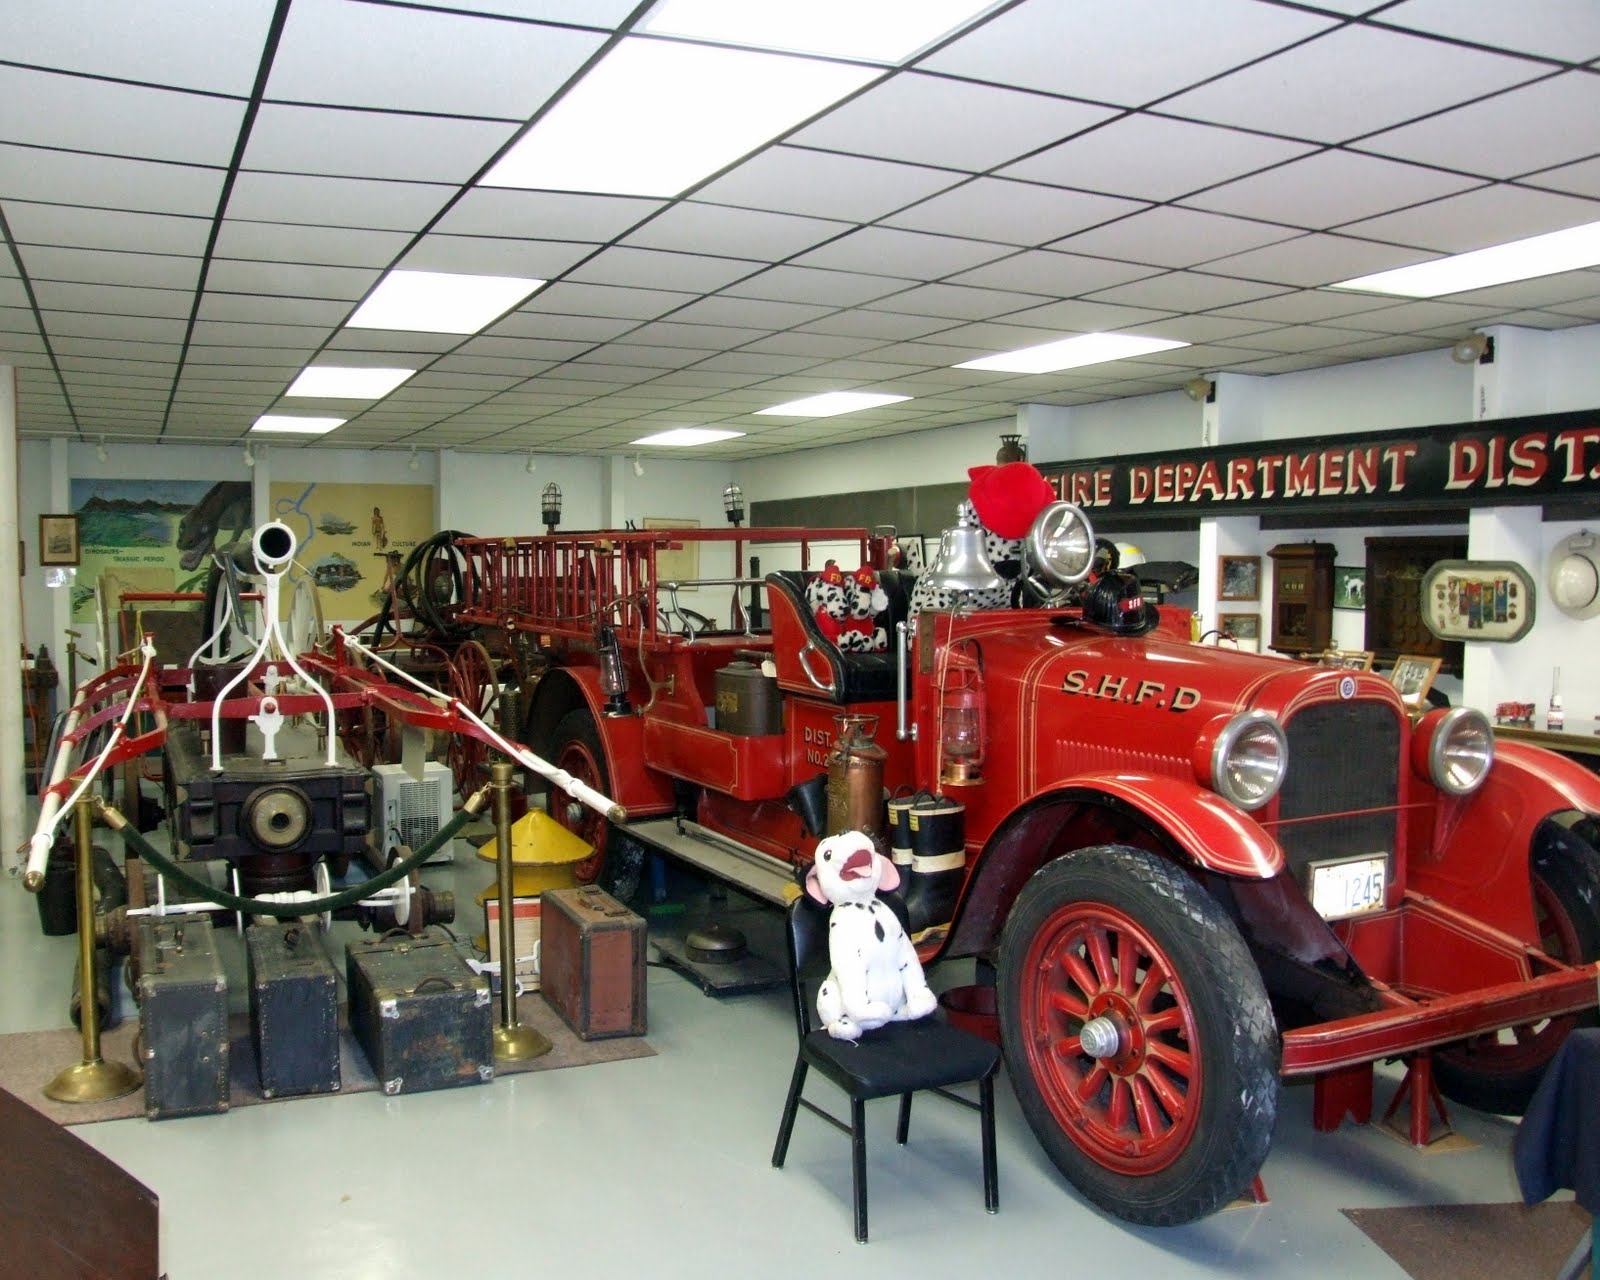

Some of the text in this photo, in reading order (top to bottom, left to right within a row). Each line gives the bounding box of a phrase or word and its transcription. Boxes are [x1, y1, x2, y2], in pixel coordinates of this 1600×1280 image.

[1129, 443, 1417, 504] DEPARTMENT
[1061, 669, 1202, 713] S.H.F.D
[804, 726, 832, 748] DIST.
[807, 748, 829, 768] NO.2
[1344, 872, 1382, 907] 1245
